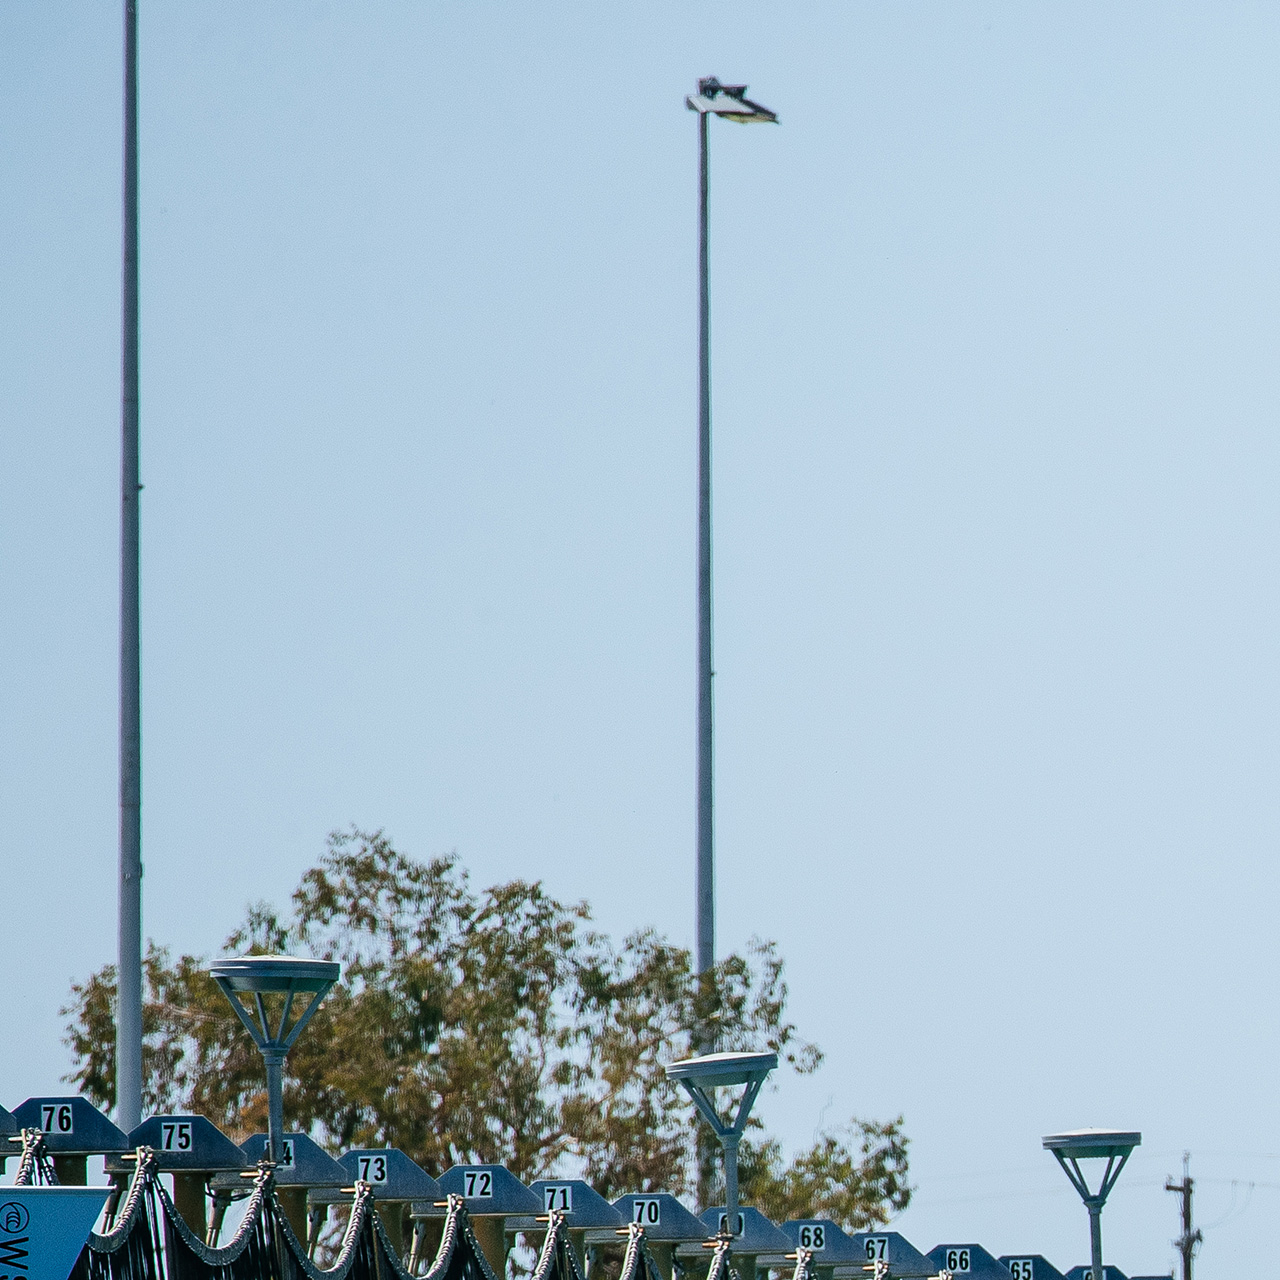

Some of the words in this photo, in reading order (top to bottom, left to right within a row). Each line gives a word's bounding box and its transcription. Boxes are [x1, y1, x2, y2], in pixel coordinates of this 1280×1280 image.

[43, 1106, 71, 1132] 76
[163, 1124, 191, 1149] 75
[359, 1158, 386, 1182] 73
[465, 1173, 491, 1196] 72
[546, 1188, 570, 1211] 71
[635, 1201, 659, 1223] 70
[801, 1226, 824, 1248] 68
[865, 1239, 887, 1260] 67
[947, 1250, 969, 1271] 66
[1010, 1261, 1031, 1280] 65
